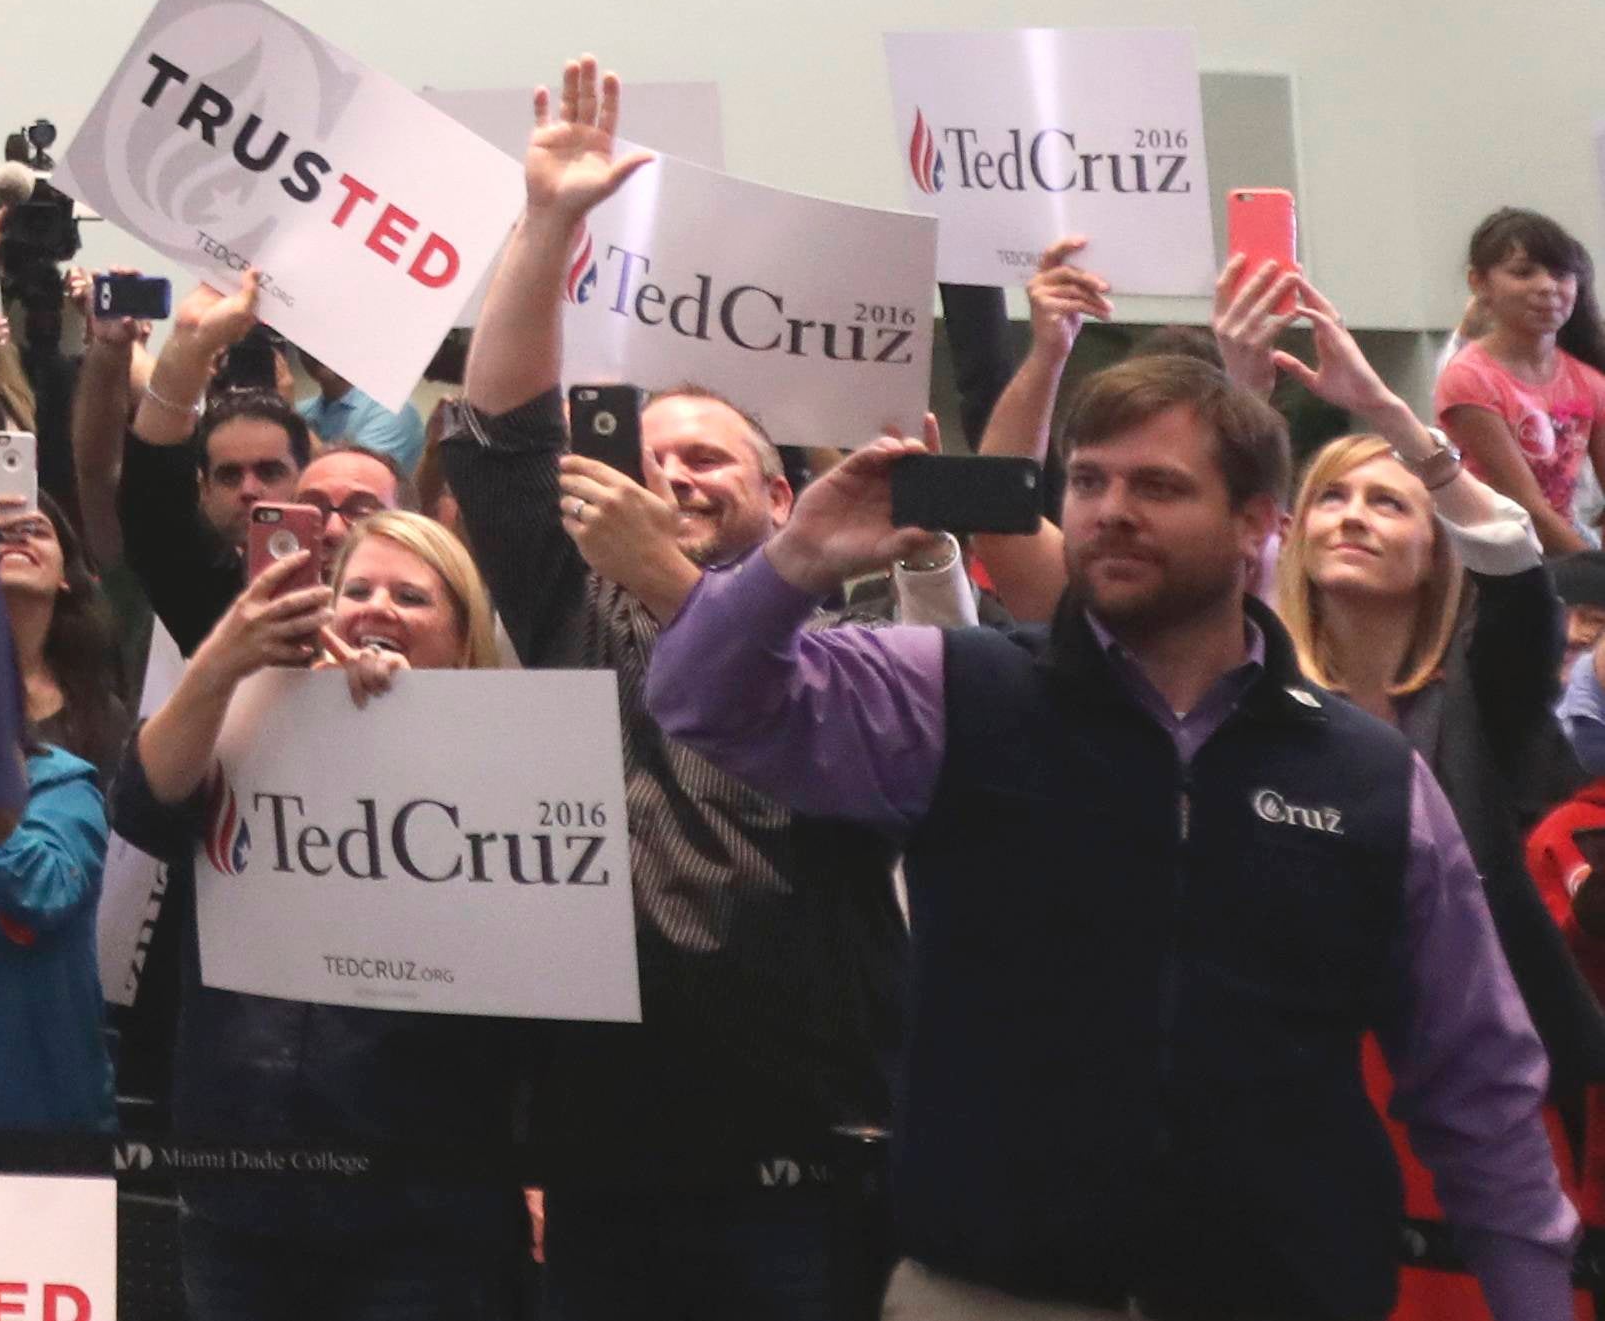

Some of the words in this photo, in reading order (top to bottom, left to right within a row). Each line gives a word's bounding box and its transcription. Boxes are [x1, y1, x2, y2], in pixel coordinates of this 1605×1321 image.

[1134, 129, 1188, 149] 2016
[141, 53, 460, 288] TRUSTED
[853, 302, 916, 325] 2016
[538, 800, 606, 827] 2016
[1253, 789, 1345, 835] Cruz
[161, 1147, 225, 1169] Miami
[231, 1149, 286, 1171] Dade
[291, 1152, 370, 1176] College
